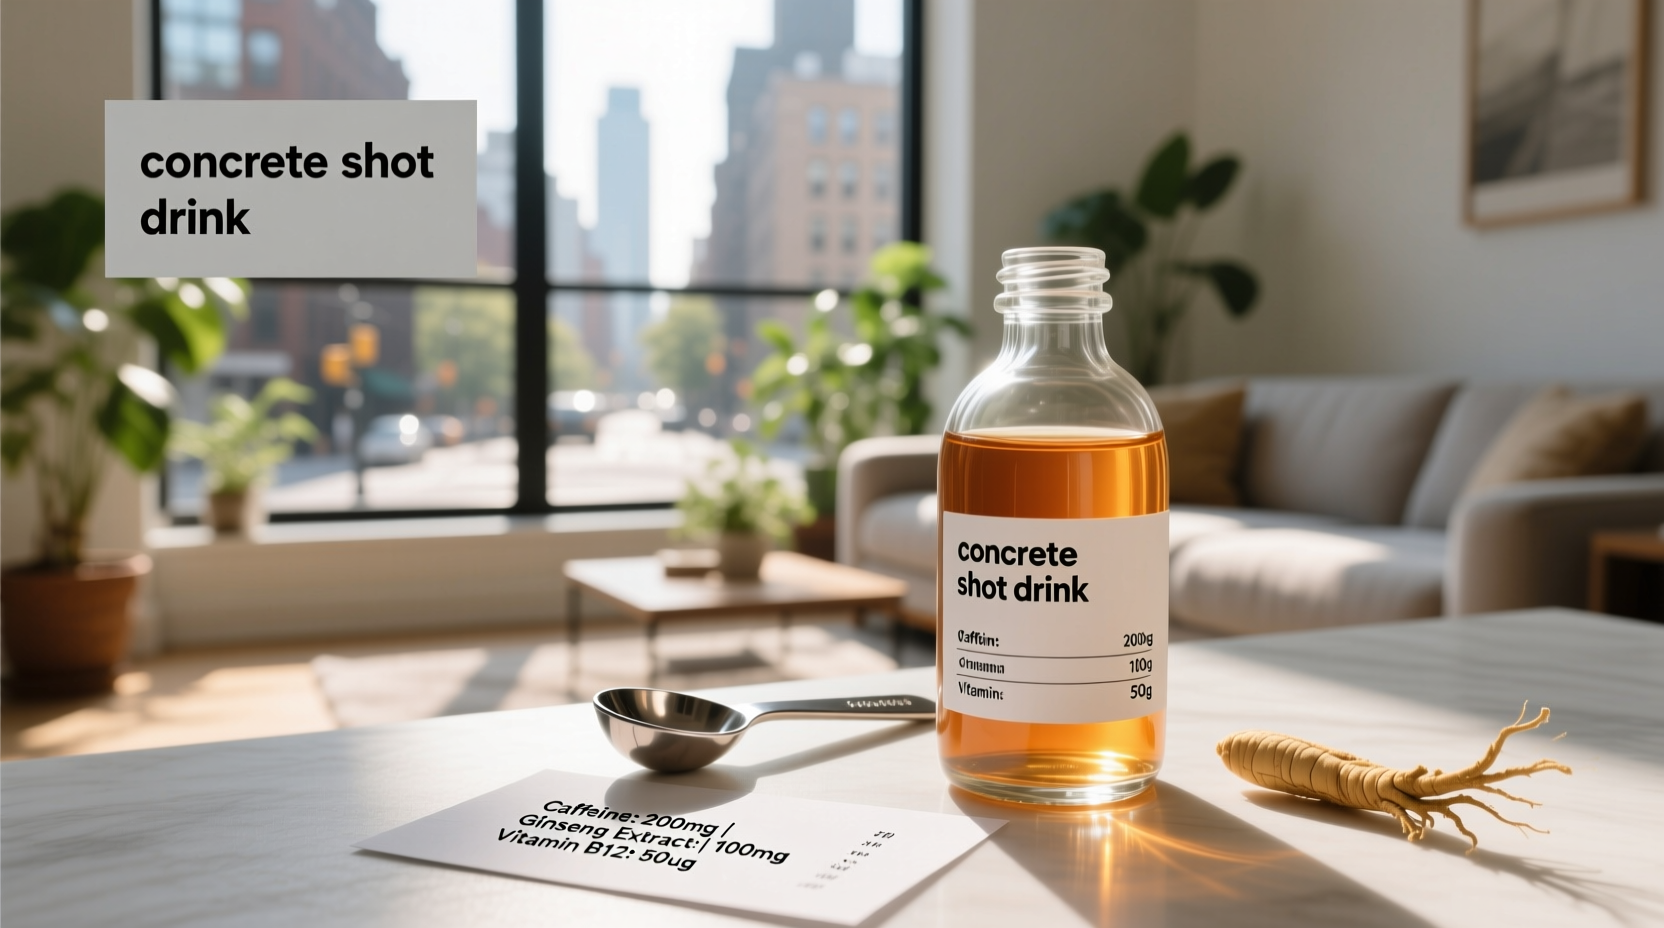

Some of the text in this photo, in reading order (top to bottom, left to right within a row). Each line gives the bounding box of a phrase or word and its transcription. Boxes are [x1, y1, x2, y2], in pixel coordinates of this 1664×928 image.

[957, 541, 1078, 567] concrete
[957, 570, 1089, 603] shot drink
[1130, 683, 1153, 701] 50g
[542, 800, 640, 823] Caffeine:
[640, 813, 720, 838] 200mg
[497, 828, 697, 872] Vitamin B12: 50ug
[518, 814, 610, 839] Ginseng
[715, 840, 791, 865] 100mg
